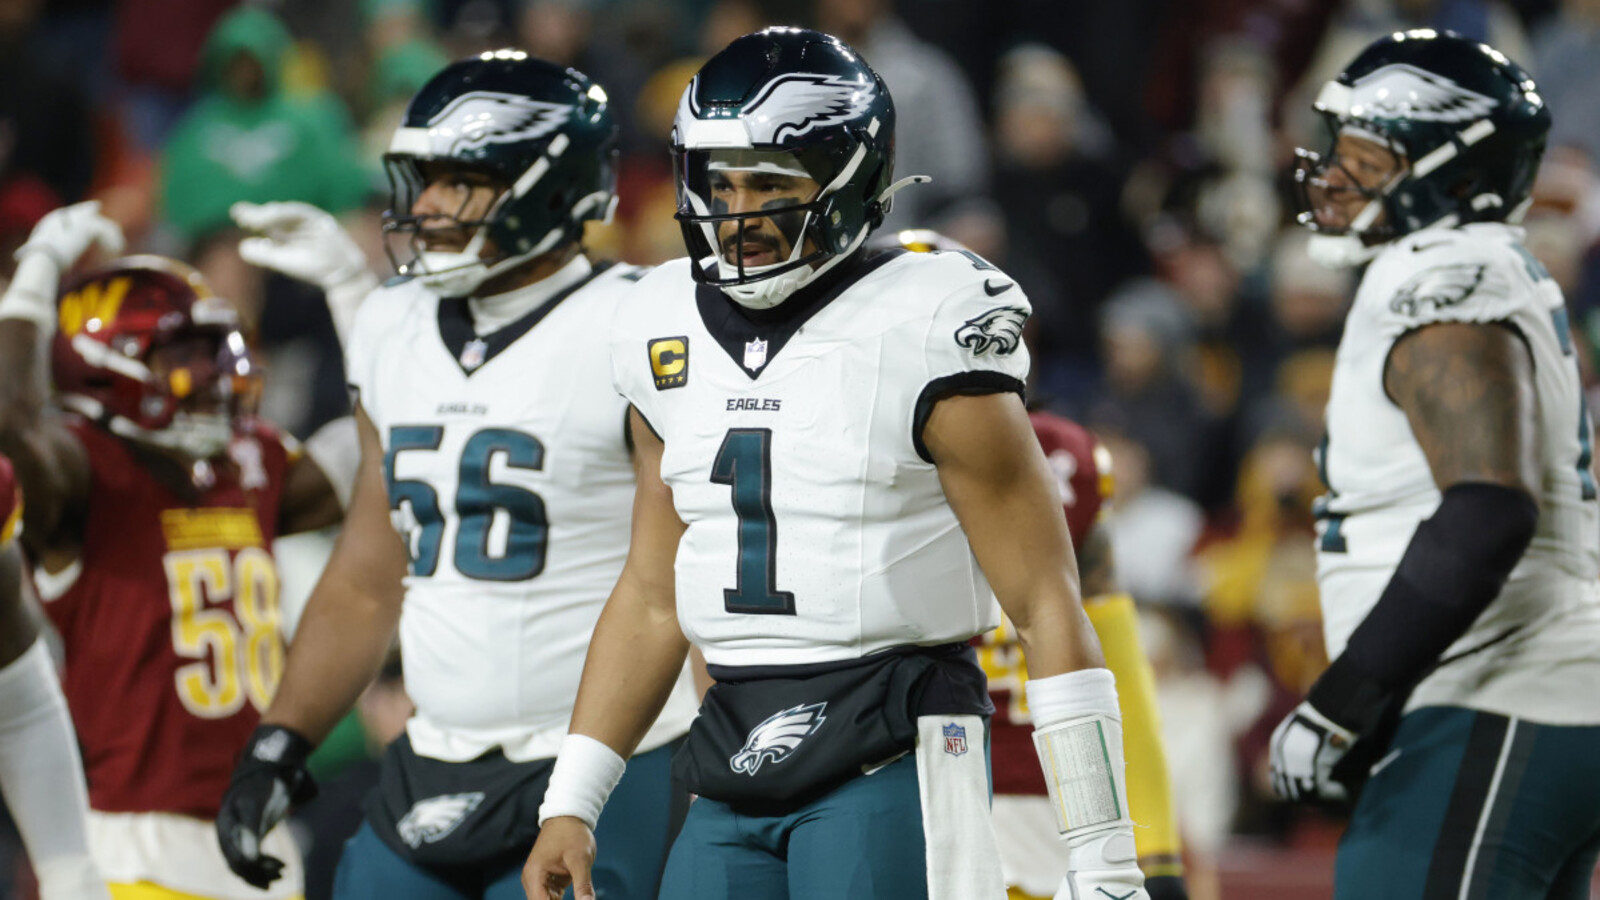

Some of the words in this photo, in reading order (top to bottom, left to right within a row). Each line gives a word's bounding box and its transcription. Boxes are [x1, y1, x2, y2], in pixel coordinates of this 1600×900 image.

[650, 340, 685, 377] C
[726, 398, 782, 411] EAGLES
[384, 425, 549, 581] 56
[710, 428, 796, 616] 1
[162, 547, 283, 719] 58
[945, 736, 966, 753] NFL
